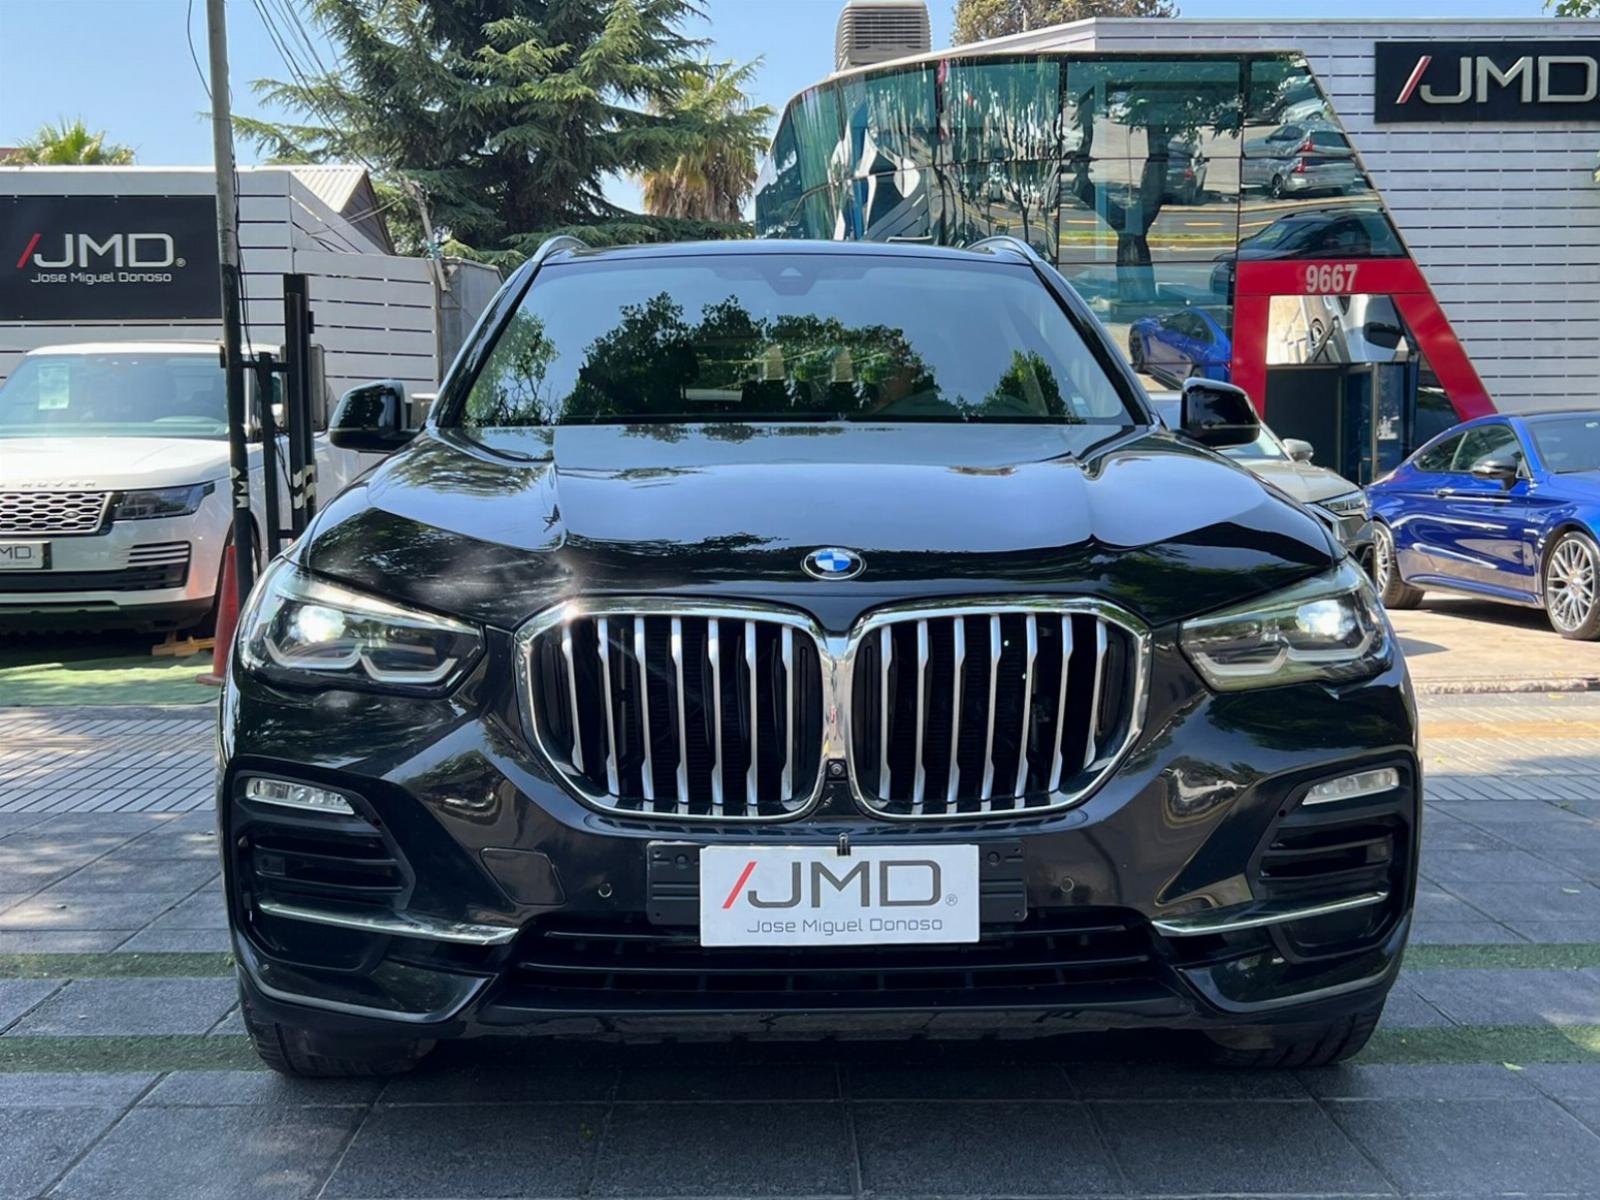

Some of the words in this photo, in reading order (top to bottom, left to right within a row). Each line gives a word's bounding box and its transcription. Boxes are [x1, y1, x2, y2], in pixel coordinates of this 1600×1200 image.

[31, 273, 67, 283] Jose
[70, 272, 115, 285] Miguel
[118, 272, 172, 283] Donoso
[1306, 264, 1358, 292] 9667
[747, 920, 796, 933] Jose
[802, 918, 863, 935] Miguel
[869, 918, 943, 931] Donoso
